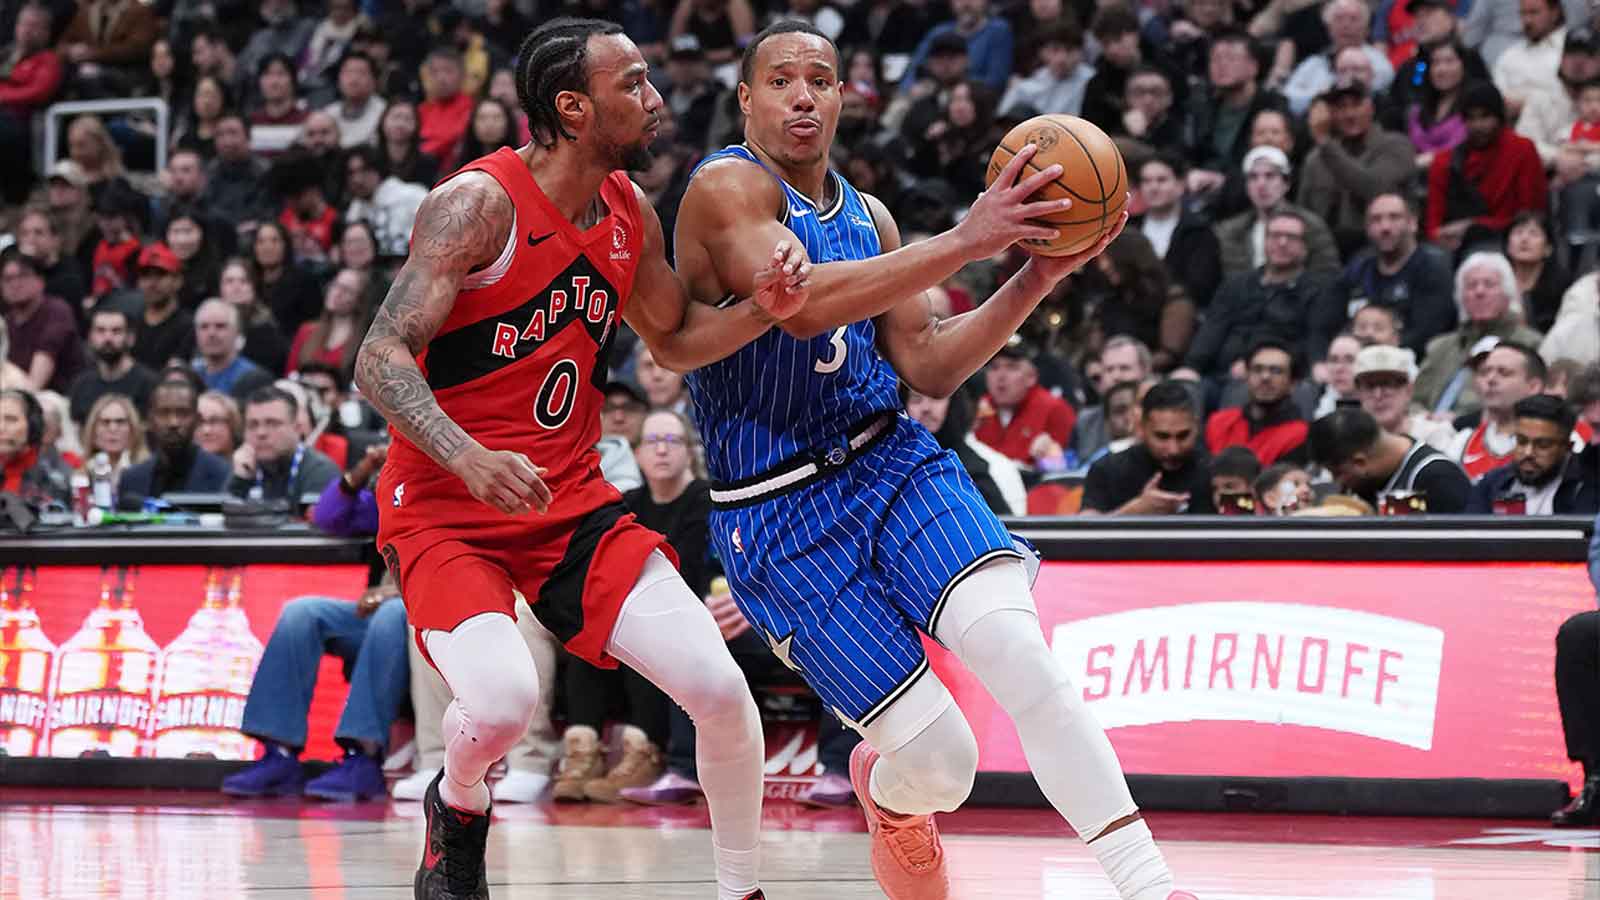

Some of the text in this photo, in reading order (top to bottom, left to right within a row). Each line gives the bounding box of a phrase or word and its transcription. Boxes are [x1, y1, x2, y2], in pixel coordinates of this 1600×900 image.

[814, 324, 848, 374] 3
[533, 358, 579, 429] 0
[1083, 631, 1404, 706] SMIRNOFF
